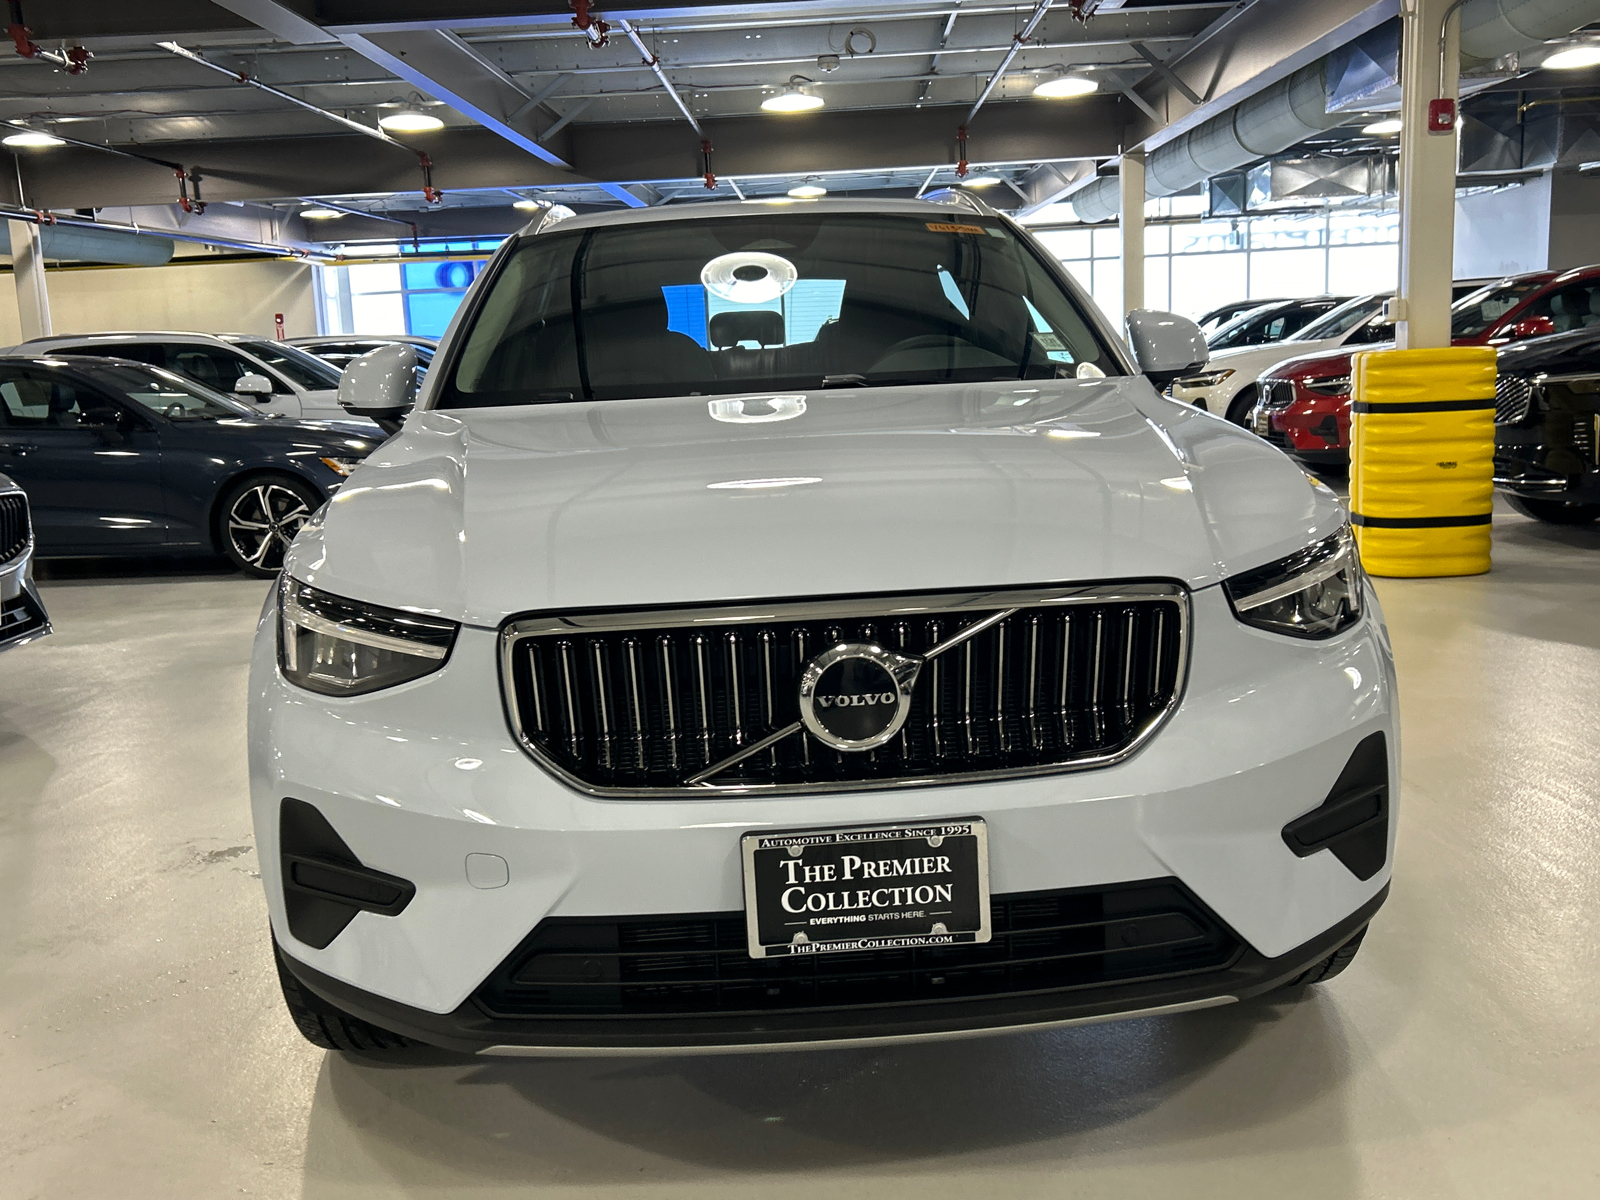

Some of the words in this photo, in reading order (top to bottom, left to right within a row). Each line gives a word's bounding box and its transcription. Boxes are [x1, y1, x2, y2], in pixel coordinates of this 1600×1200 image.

[817, 692, 896, 708] VOLVO
[761, 835, 832, 848] AUTOMOTIVE
[835, 830, 902, 842] EXCELLENCE
[904, 827, 937, 837] SINCE
[940, 825, 970, 835] 1995
[779, 859, 837, 884] THE
[841, 855, 952, 880] PREMIER
[780, 884, 953, 914] COLLECTION
[809, 914, 867, 926] EVERYTHING
[867, 911, 900, 922] STARTS
[901, 910, 927, 919] HERE.
[787, 935, 953, 954] THEPREMIERCOLLECTION.COM
